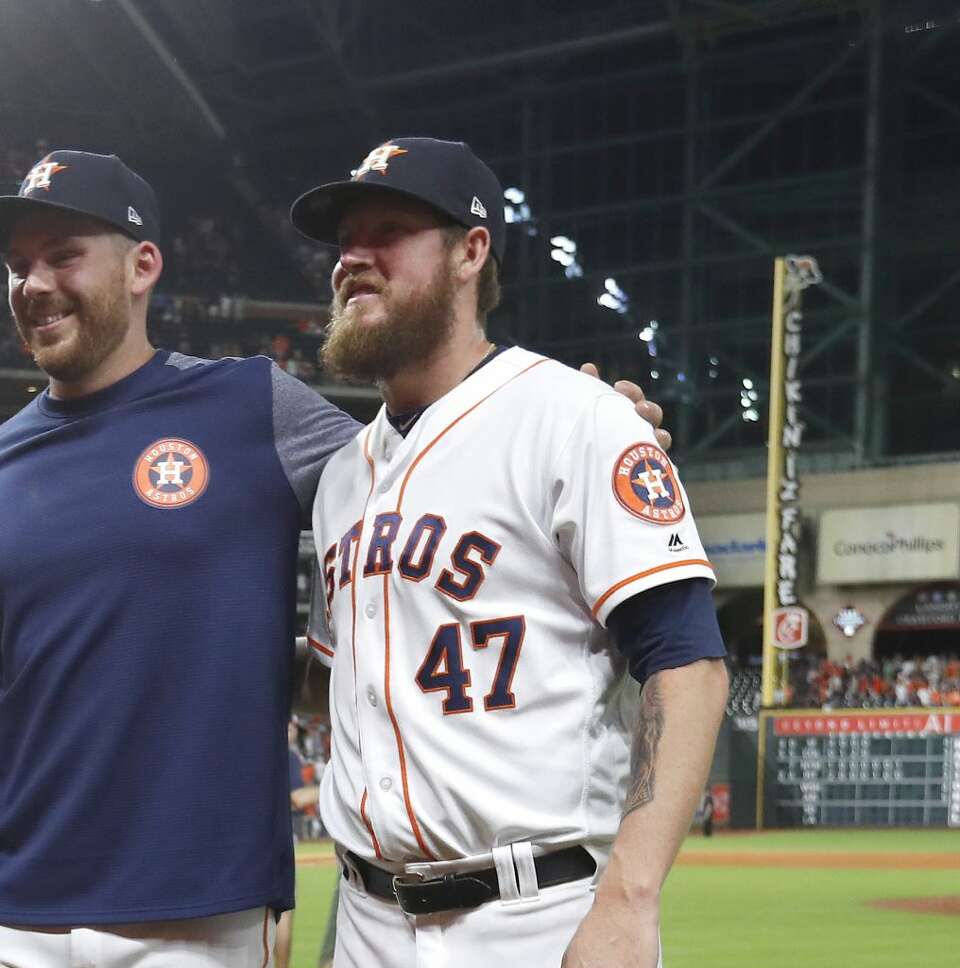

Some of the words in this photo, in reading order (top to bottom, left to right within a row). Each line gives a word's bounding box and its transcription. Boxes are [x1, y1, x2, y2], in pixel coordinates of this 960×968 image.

[24, 162, 59, 196] H
[144, 442, 199, 463] HOUSTON
[156, 460, 185, 485] H
[637, 468, 671, 500] H
[145, 487, 195, 503] ASTROS
[414, 614, 527, 716] 47
